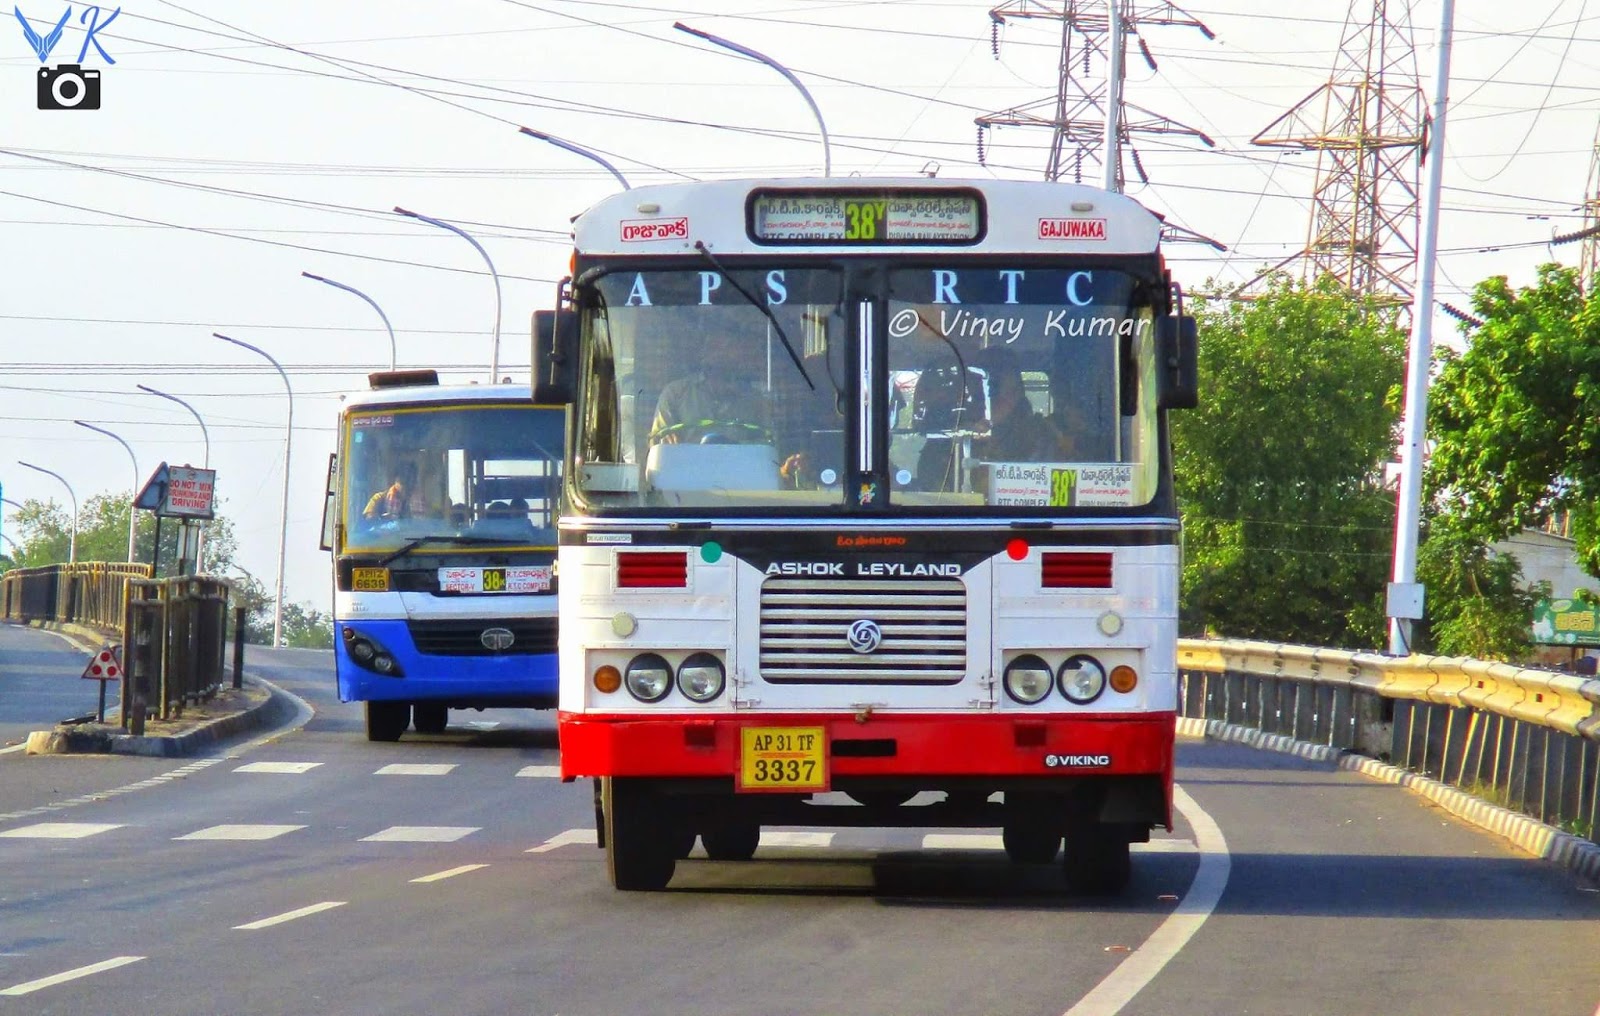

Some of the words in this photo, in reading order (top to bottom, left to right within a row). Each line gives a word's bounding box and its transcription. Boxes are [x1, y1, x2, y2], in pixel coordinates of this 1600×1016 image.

[623, 220, 686, 239] గాజువాక
[1040, 220, 1104, 237] GAJUWAKA
[172, 498, 205, 508] DRIVING
[765, 562, 845, 575] ASHOK
[857, 562, 962, 576] LEYLAND
[753, 735, 773, 751] AP
[776, 735, 792, 751] 31
[797, 735, 815, 751] TF
[1059, 755, 1109, 765] VIKING
[754, 759, 816, 781] 3337
